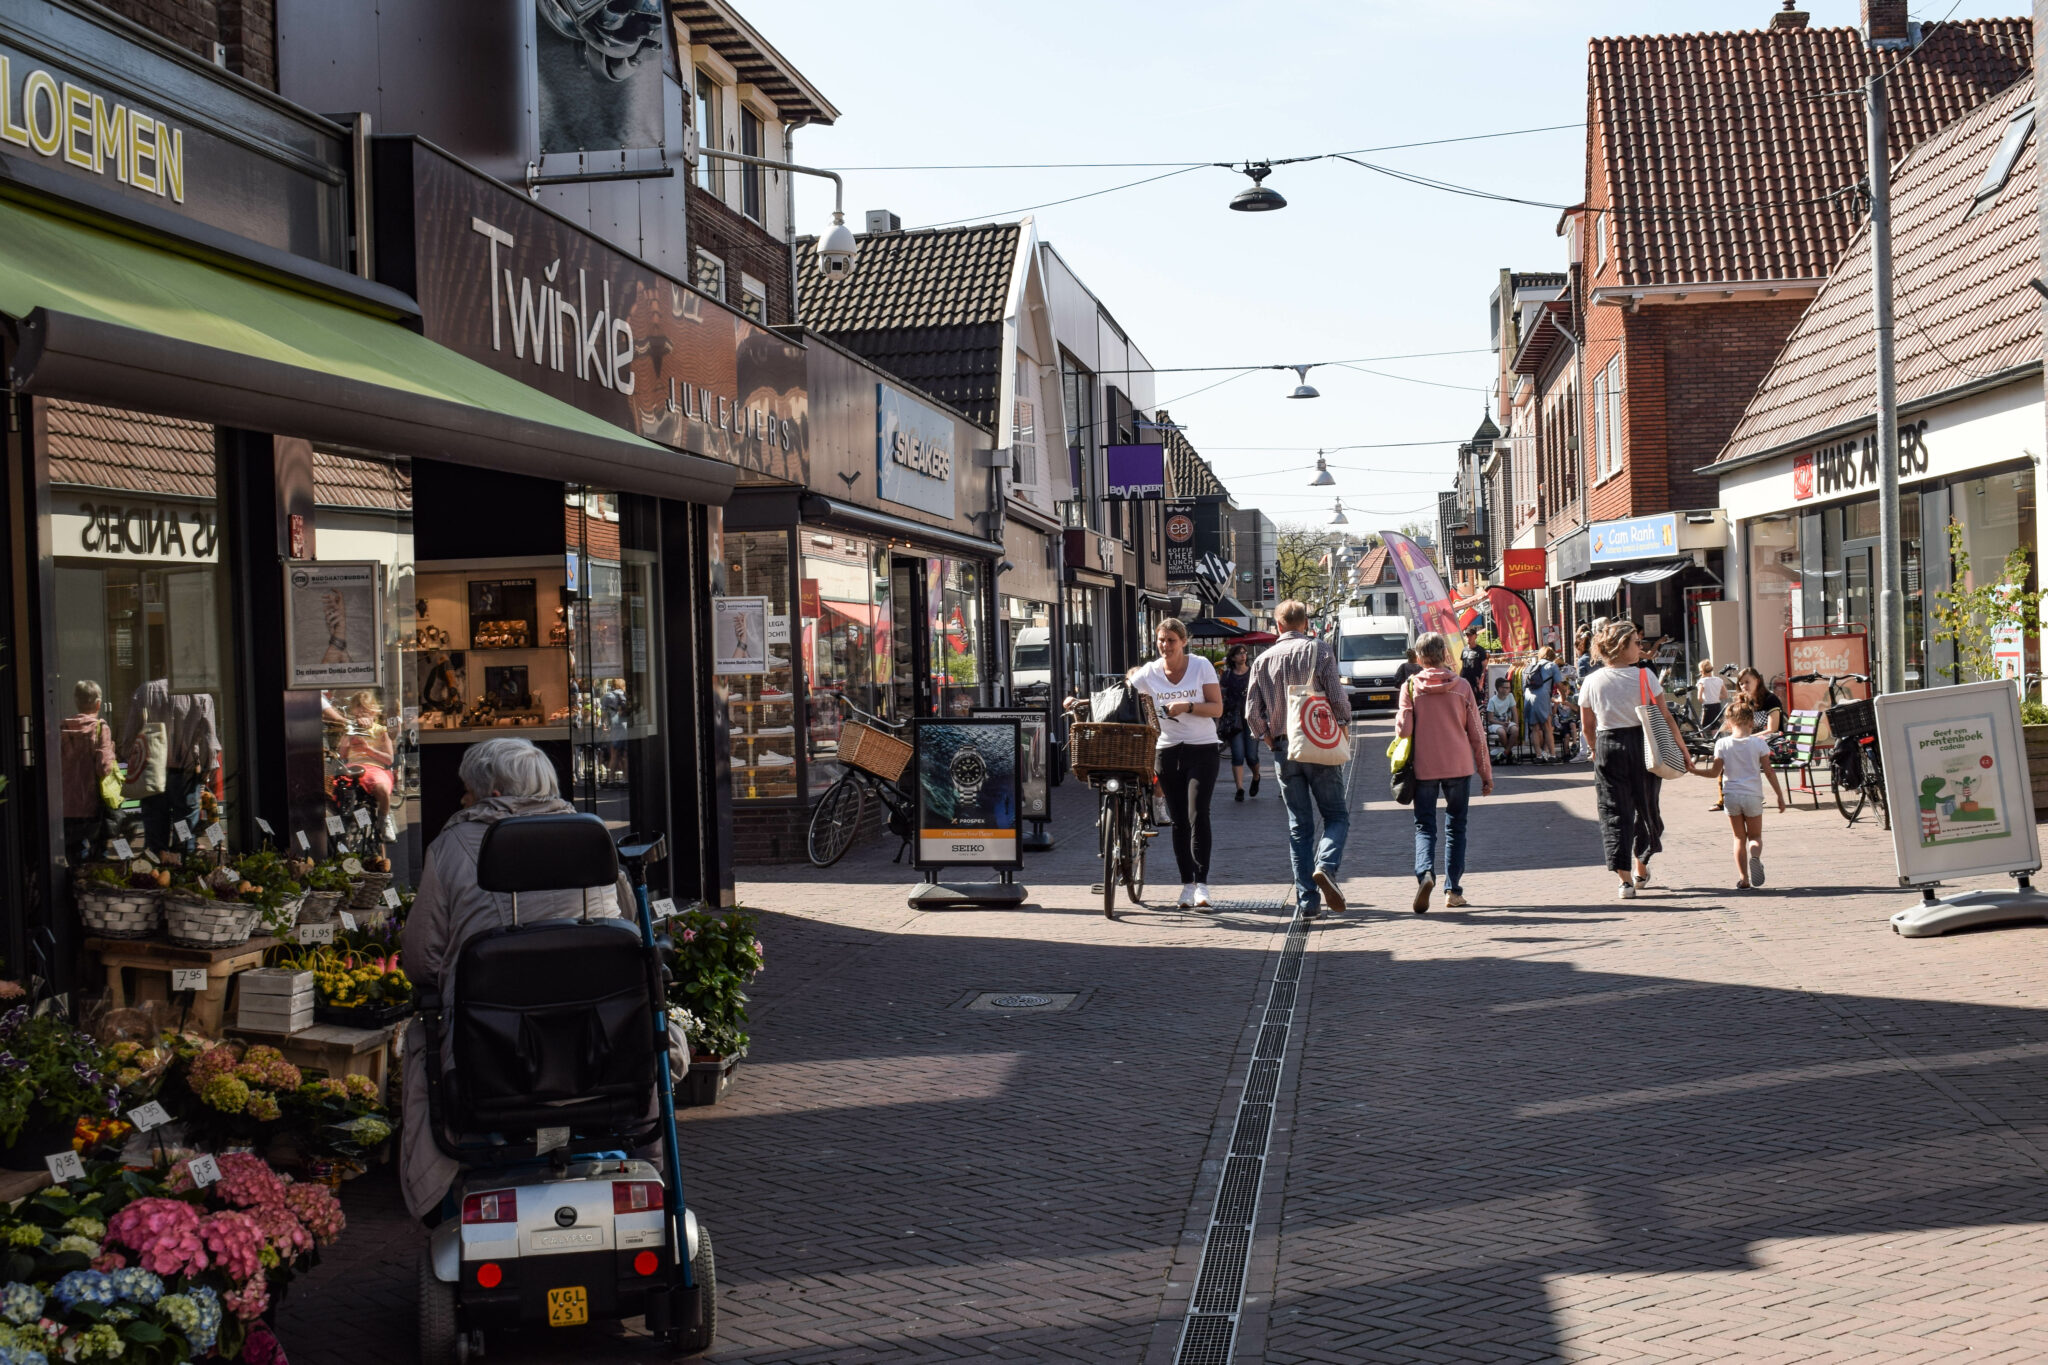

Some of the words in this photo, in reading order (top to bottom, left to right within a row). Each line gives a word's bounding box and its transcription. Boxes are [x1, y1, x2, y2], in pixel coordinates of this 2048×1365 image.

[472, 217, 635, 396] Twinkle
[666, 377, 790, 450] JUWELIERS
[894, 431, 950, 481] SNEAKERS
[1816, 440, 1857, 495] HANS
[1860, 419, 1929, 487] ANERS
[1608, 528, 1628, 545] Cam
[1630, 523, 1655, 542] Ranh
[1508, 562, 1542, 572] Wibra
[1793, 646, 1825, 658] 40%
[1793, 656, 1849, 671] korting
[1919, 730, 1984, 750] prentenboek
[1933, 729, 1952, 738] Geef
[1939, 743, 1966, 752] cadeau
[551, 1290, 584, 1304] VGL
[552, 1307, 584, 1320] 451
